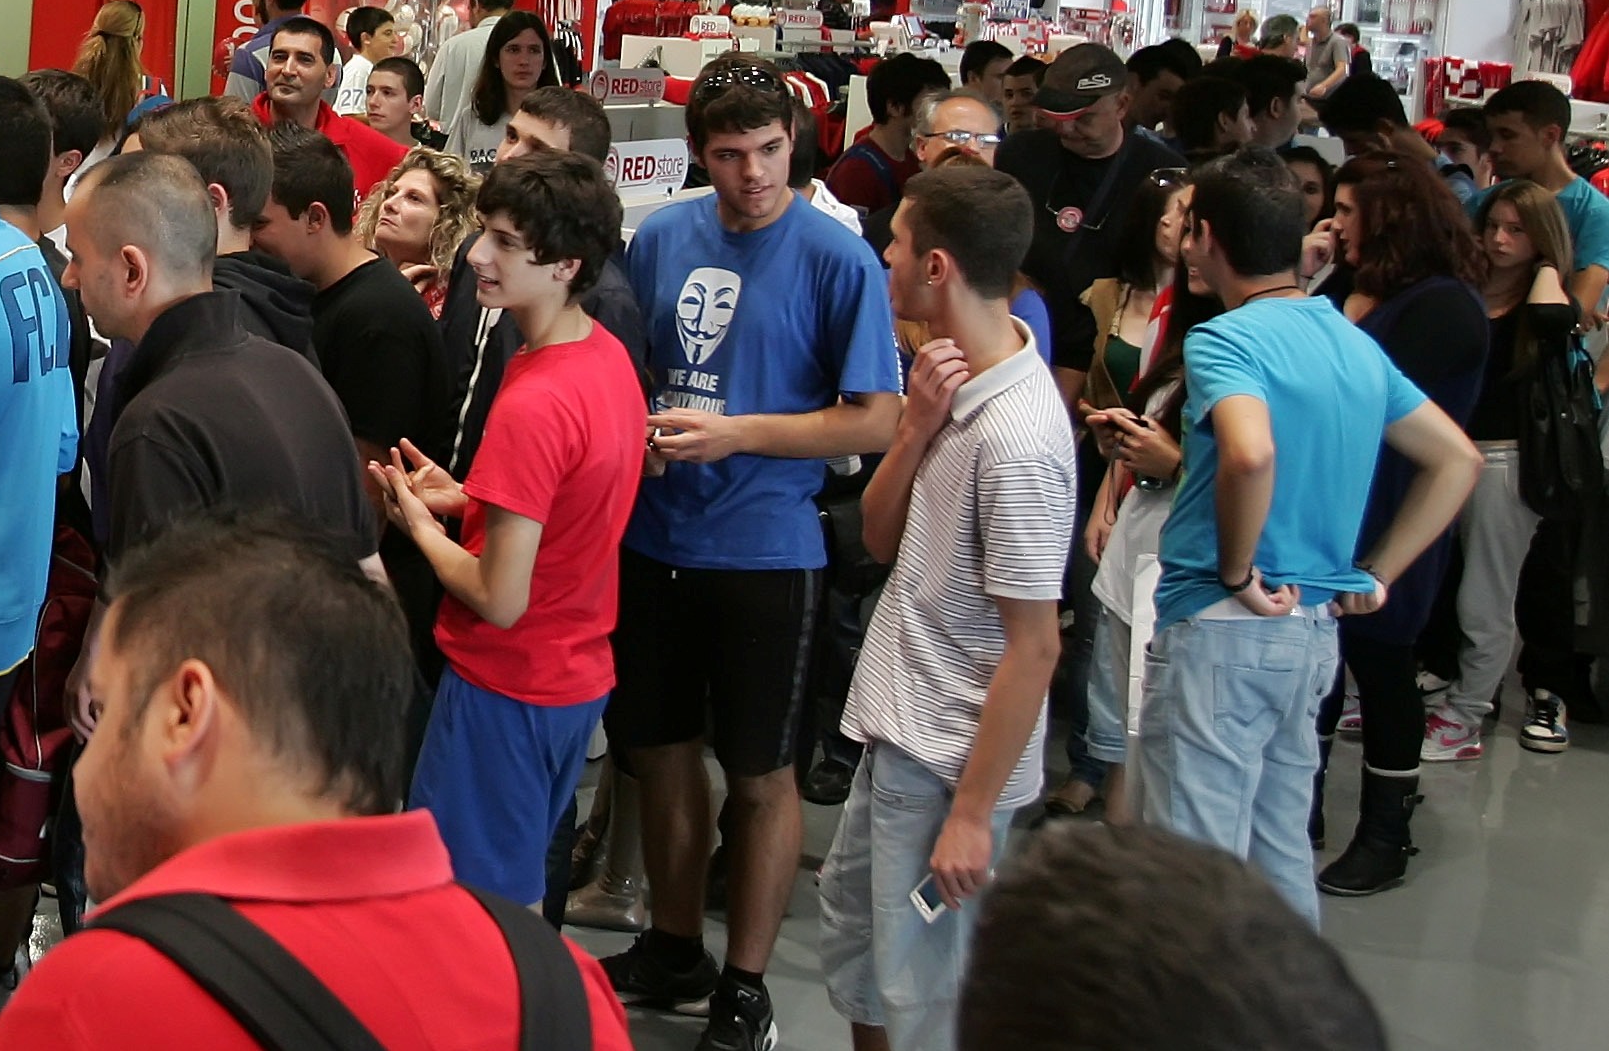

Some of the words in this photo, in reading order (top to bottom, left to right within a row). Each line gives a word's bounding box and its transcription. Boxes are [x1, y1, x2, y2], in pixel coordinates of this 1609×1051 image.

[612, 79, 638, 94] RED
[640, 79, 661, 93] store
[341, 89, 363, 106] 27
[622, 156, 656, 181] RED
[657, 154, 684, 175] store
[687, 371, 720, 392] ARE
